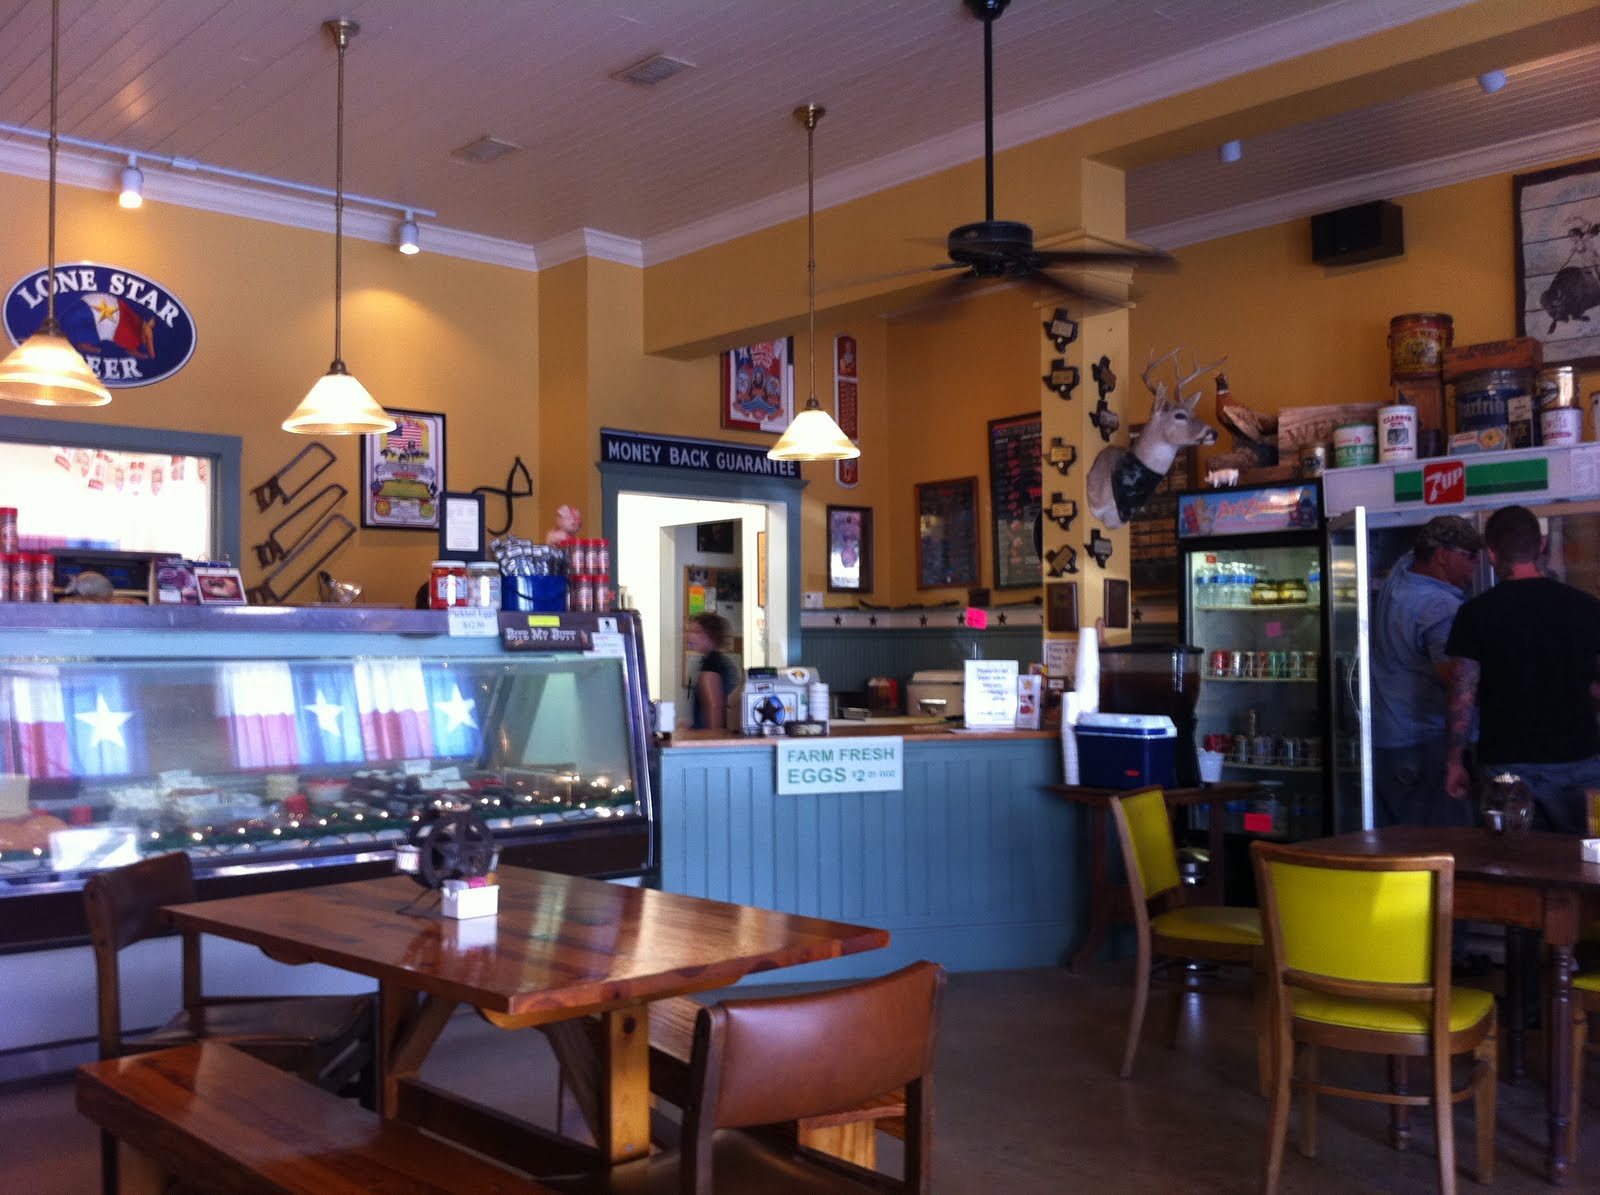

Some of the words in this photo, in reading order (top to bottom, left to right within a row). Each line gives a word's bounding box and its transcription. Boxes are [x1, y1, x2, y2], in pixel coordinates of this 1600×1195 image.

[17, 269, 98, 309] LONE
[109, 273, 180, 328] STAR
[85, 354, 143, 380] EER
[608, 440, 661, 463] MONEY
[670, 447, 710, 469] BACK
[716, 452, 795, 477] GUARANTEE
[787, 749, 834, 762] FARM
[839, 747, 895, 761] FRESH
[788, 767, 847, 784] EGGS
